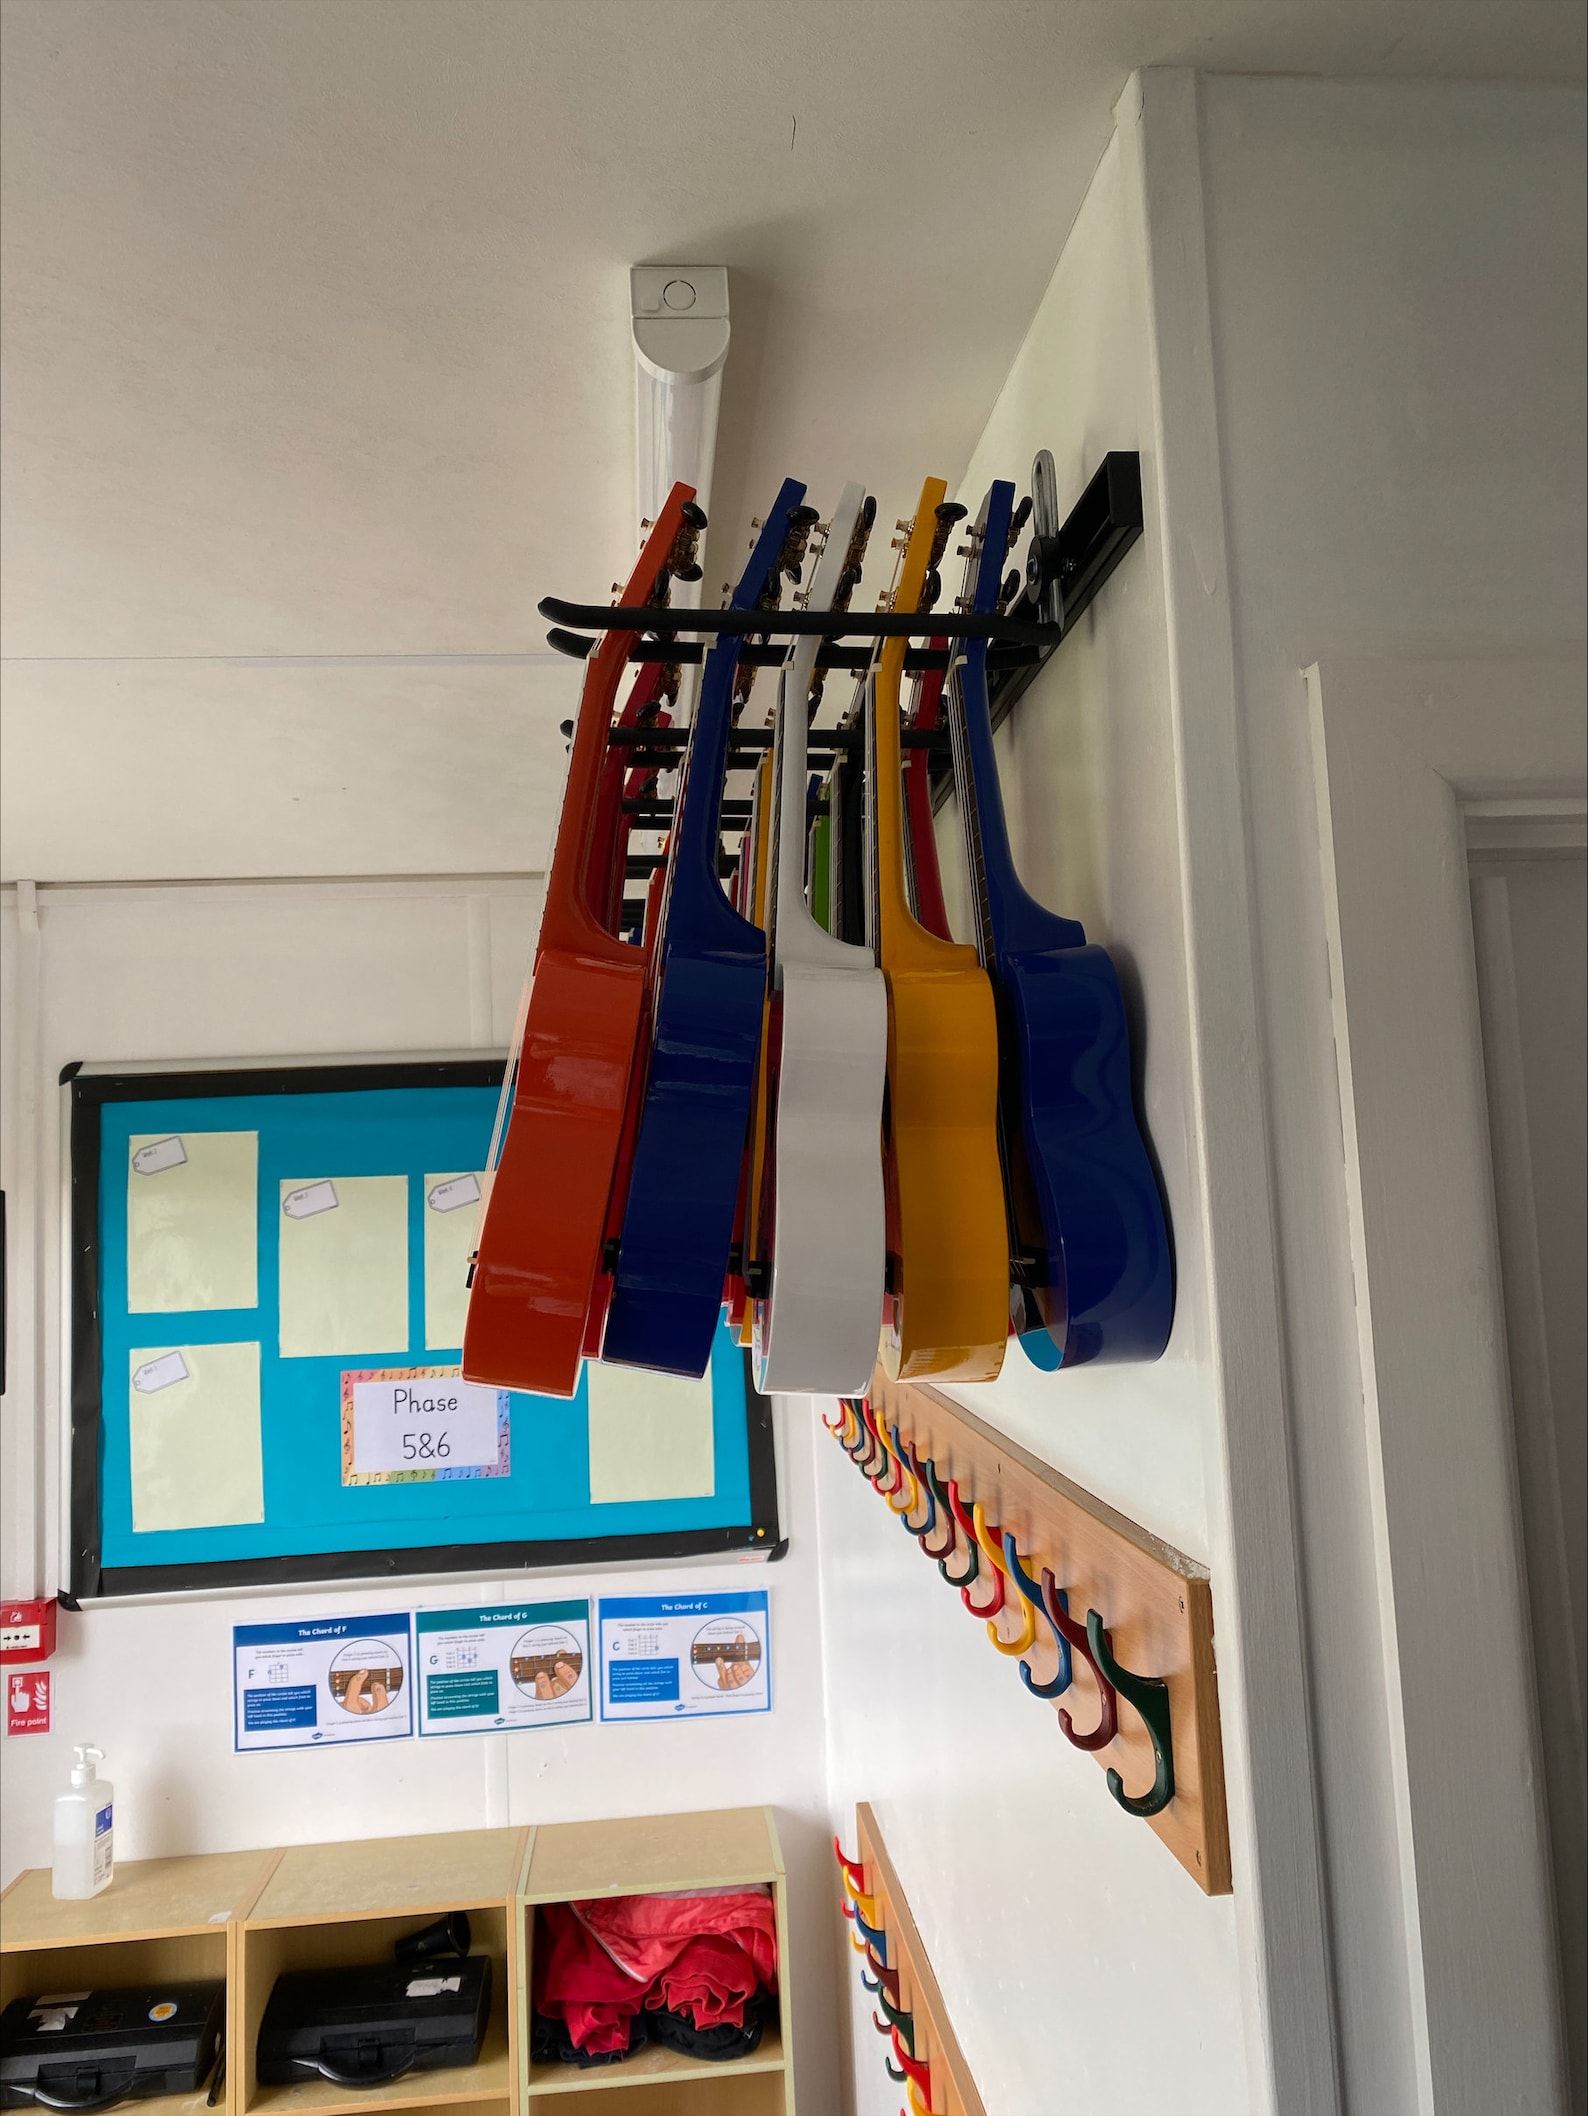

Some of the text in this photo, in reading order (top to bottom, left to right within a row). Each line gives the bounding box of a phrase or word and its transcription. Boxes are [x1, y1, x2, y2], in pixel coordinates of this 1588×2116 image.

[394, 1388, 458, 1414] Phase
[403, 1432, 450, 1460] 5&6
[674, 1602, 694, 1611] Chord
[694, 1602, 702, 1611] of
[492, 1613, 512, 1621] Chord
[513, 1612, 521, 1621] of
[312, 1627, 332, 1635] Chord
[333, 1625, 341, 1634] of
[612, 1641, 620, 1651] C
[429, 1655, 438, 1665] G
[248, 1669, 255, 1679] F
[11, 1717, 47, 1727] Fire point
